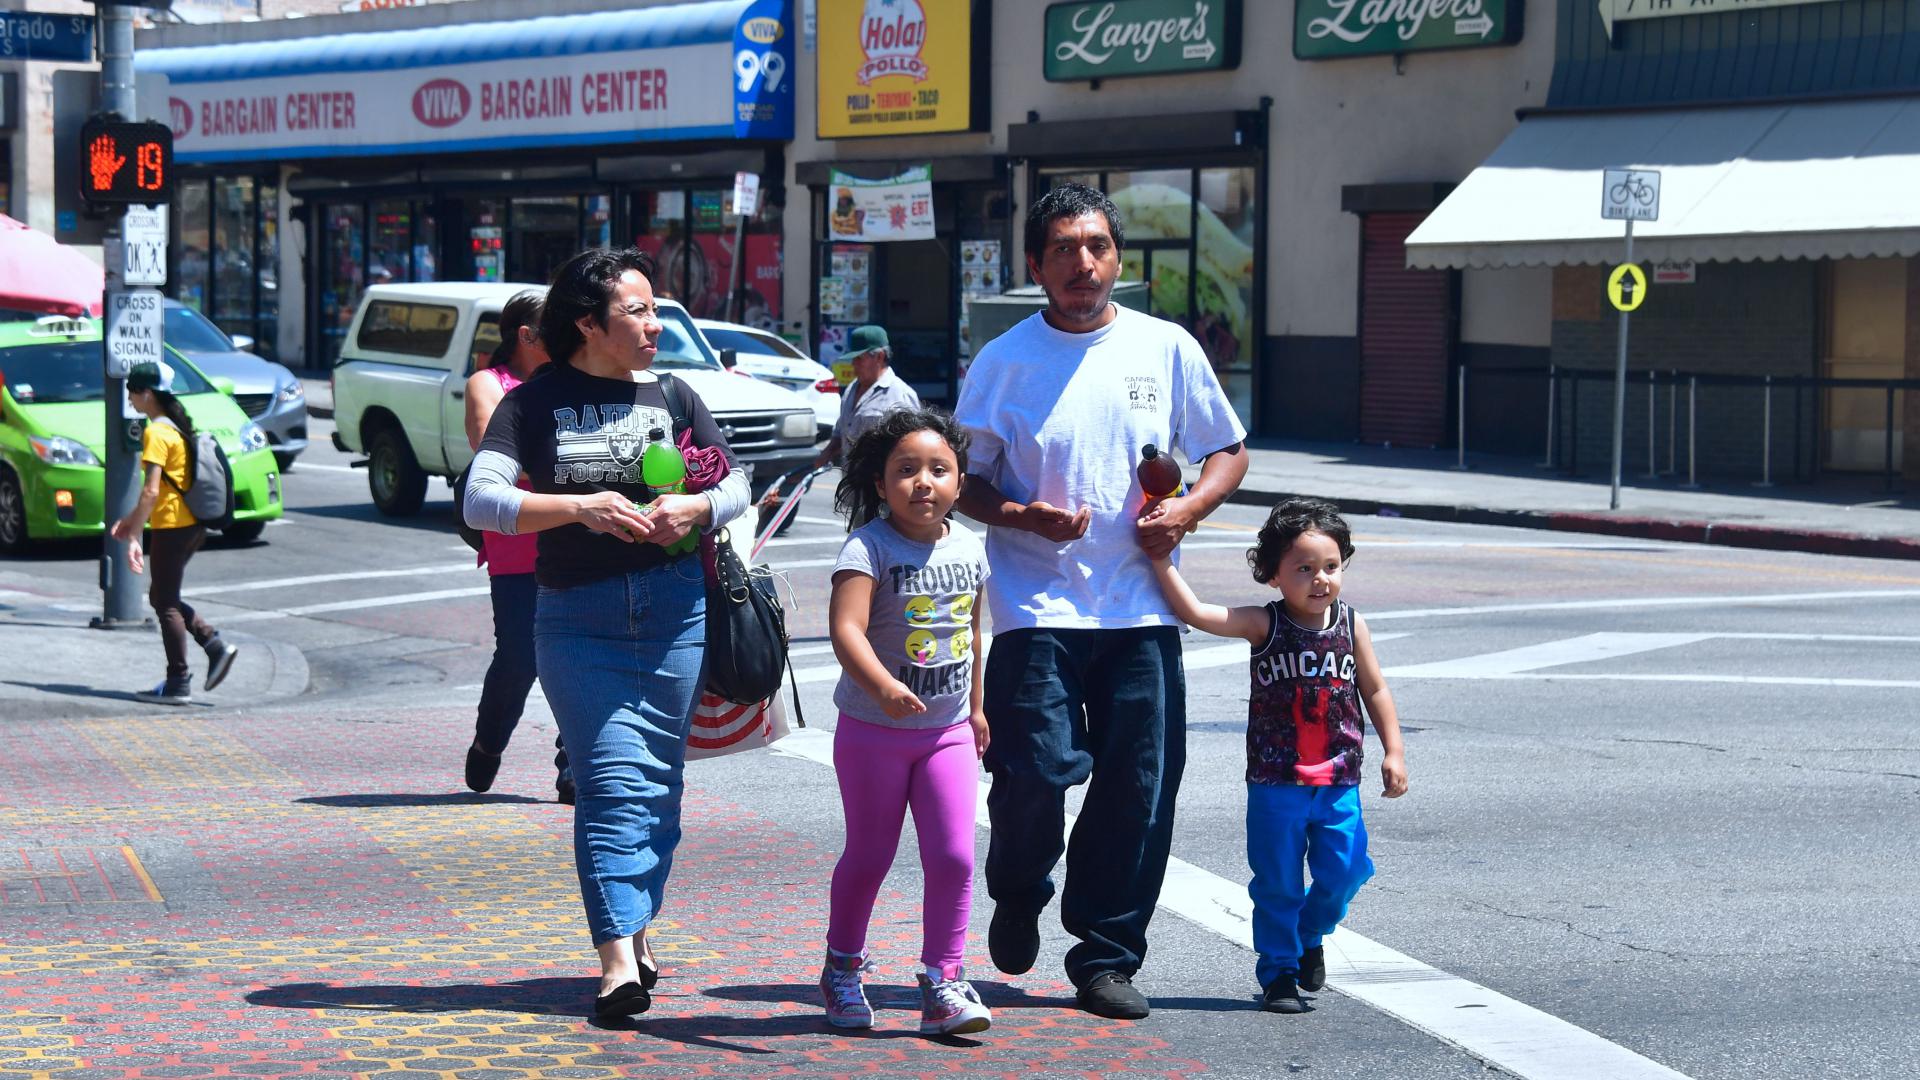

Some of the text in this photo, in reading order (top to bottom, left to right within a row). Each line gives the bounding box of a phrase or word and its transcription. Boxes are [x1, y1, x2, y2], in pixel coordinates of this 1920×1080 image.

[0, 16, 87, 40] arado St
[750, 22, 778, 38] VIVA
[865, 14, 923, 50] Hola!
[1307, 0, 1482, 42] Langers
[1055, 2, 1209, 64] Langer's
[734, 49, 786, 93] 99
[865, 58, 920, 77] POLLO
[421, 69, 668, 121] VIVA BARGAIN CENTER
[847, 94, 870, 110] POLLO
[918, 88, 939, 106] TACO
[202, 97, 278, 137] BARGAIN
[285, 91, 357, 131] CENTER
[137, 142, 164, 190] 19
[128, 215, 159, 229] CROSSING
[1609, 207, 1652, 217] BIKE LANE
[127, 242, 142, 273] OK
[117, 296, 156, 311] CROSS
[48, 321, 82, 333] TAXI
[129, 312, 142, 323] ON
[120, 326, 153, 340] WALK
[114, 342, 158, 356] SIGNAL
